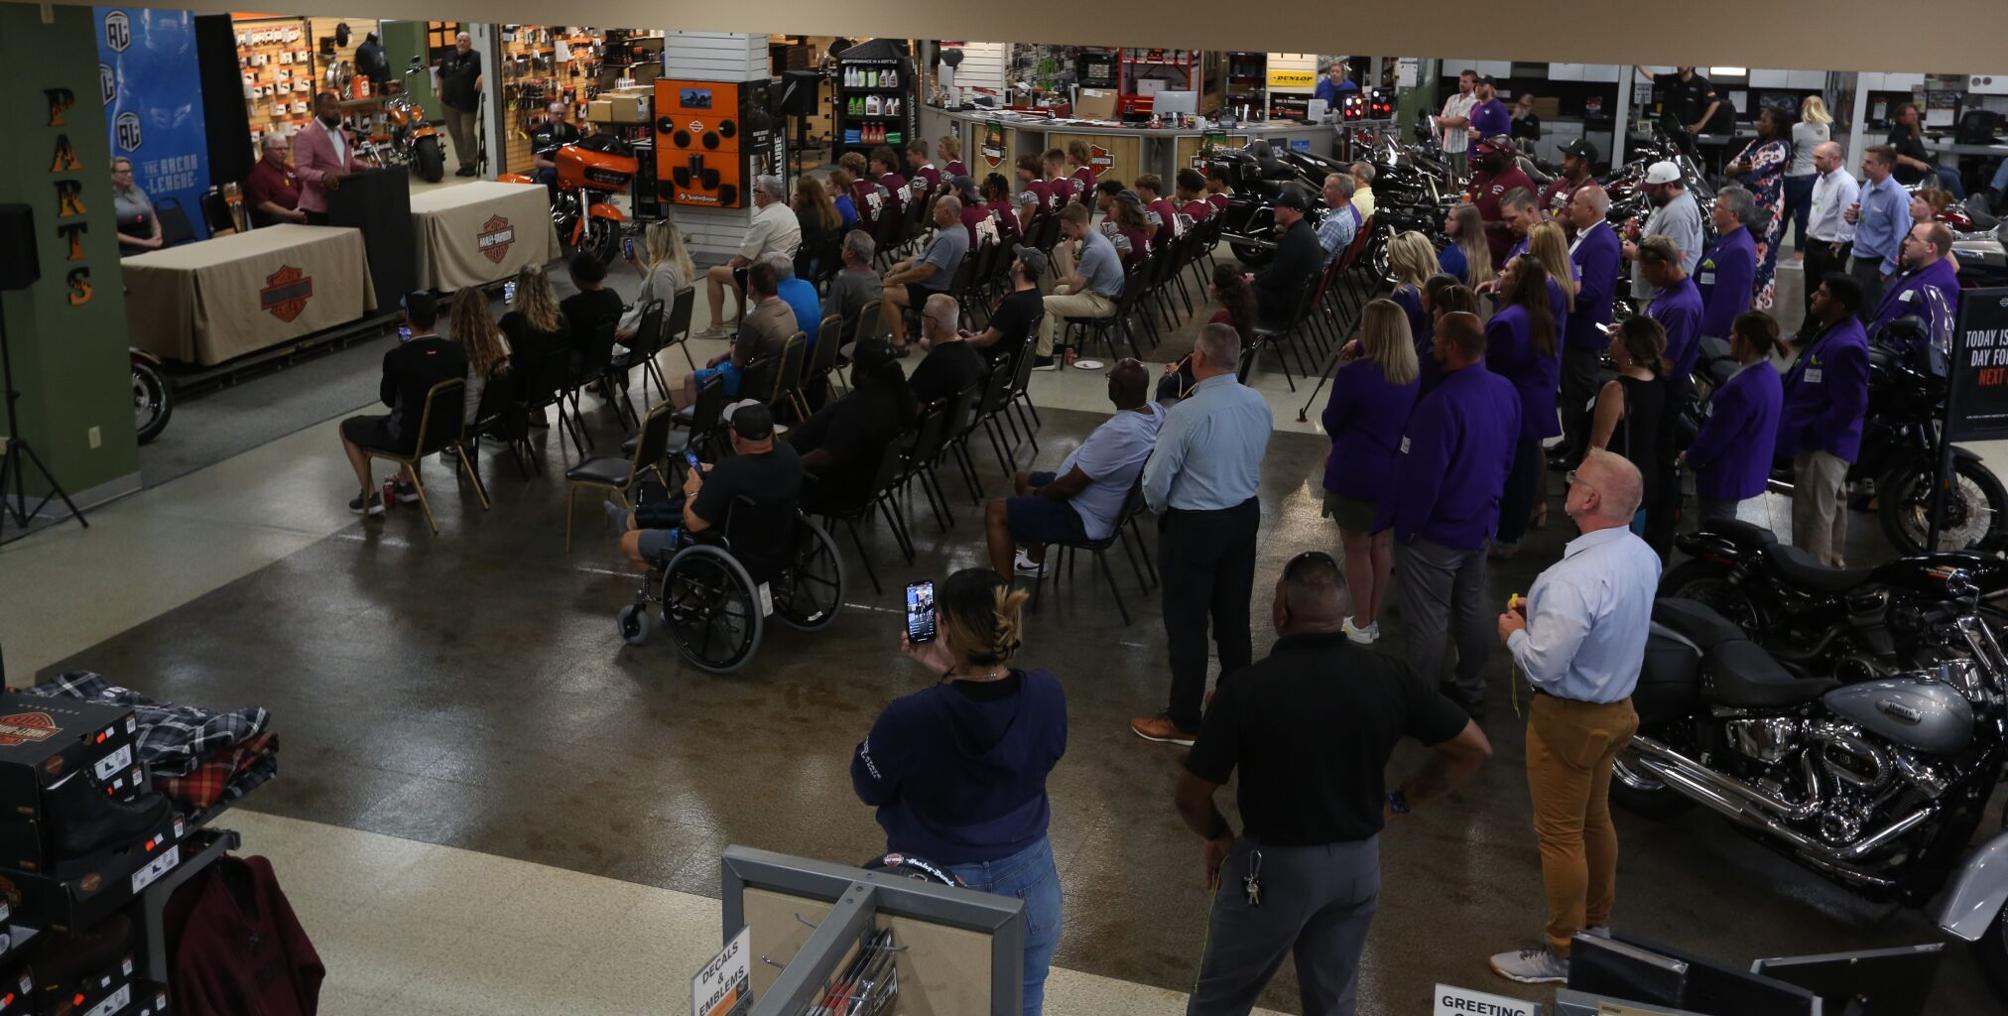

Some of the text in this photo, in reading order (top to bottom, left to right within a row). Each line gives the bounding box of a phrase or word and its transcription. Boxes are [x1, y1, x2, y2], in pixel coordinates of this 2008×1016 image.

[44, 88, 93, 306] PARTS
[1966, 329, 1997, 348] TODAY
[1971, 348, 2008, 367] DAY FO
[1977, 367, 2005, 385] NEXT
[702, 941, 738, 984] DECALS
[717, 971, 724, 985] &
[699, 965, 745, 1016] EMBLEMS
